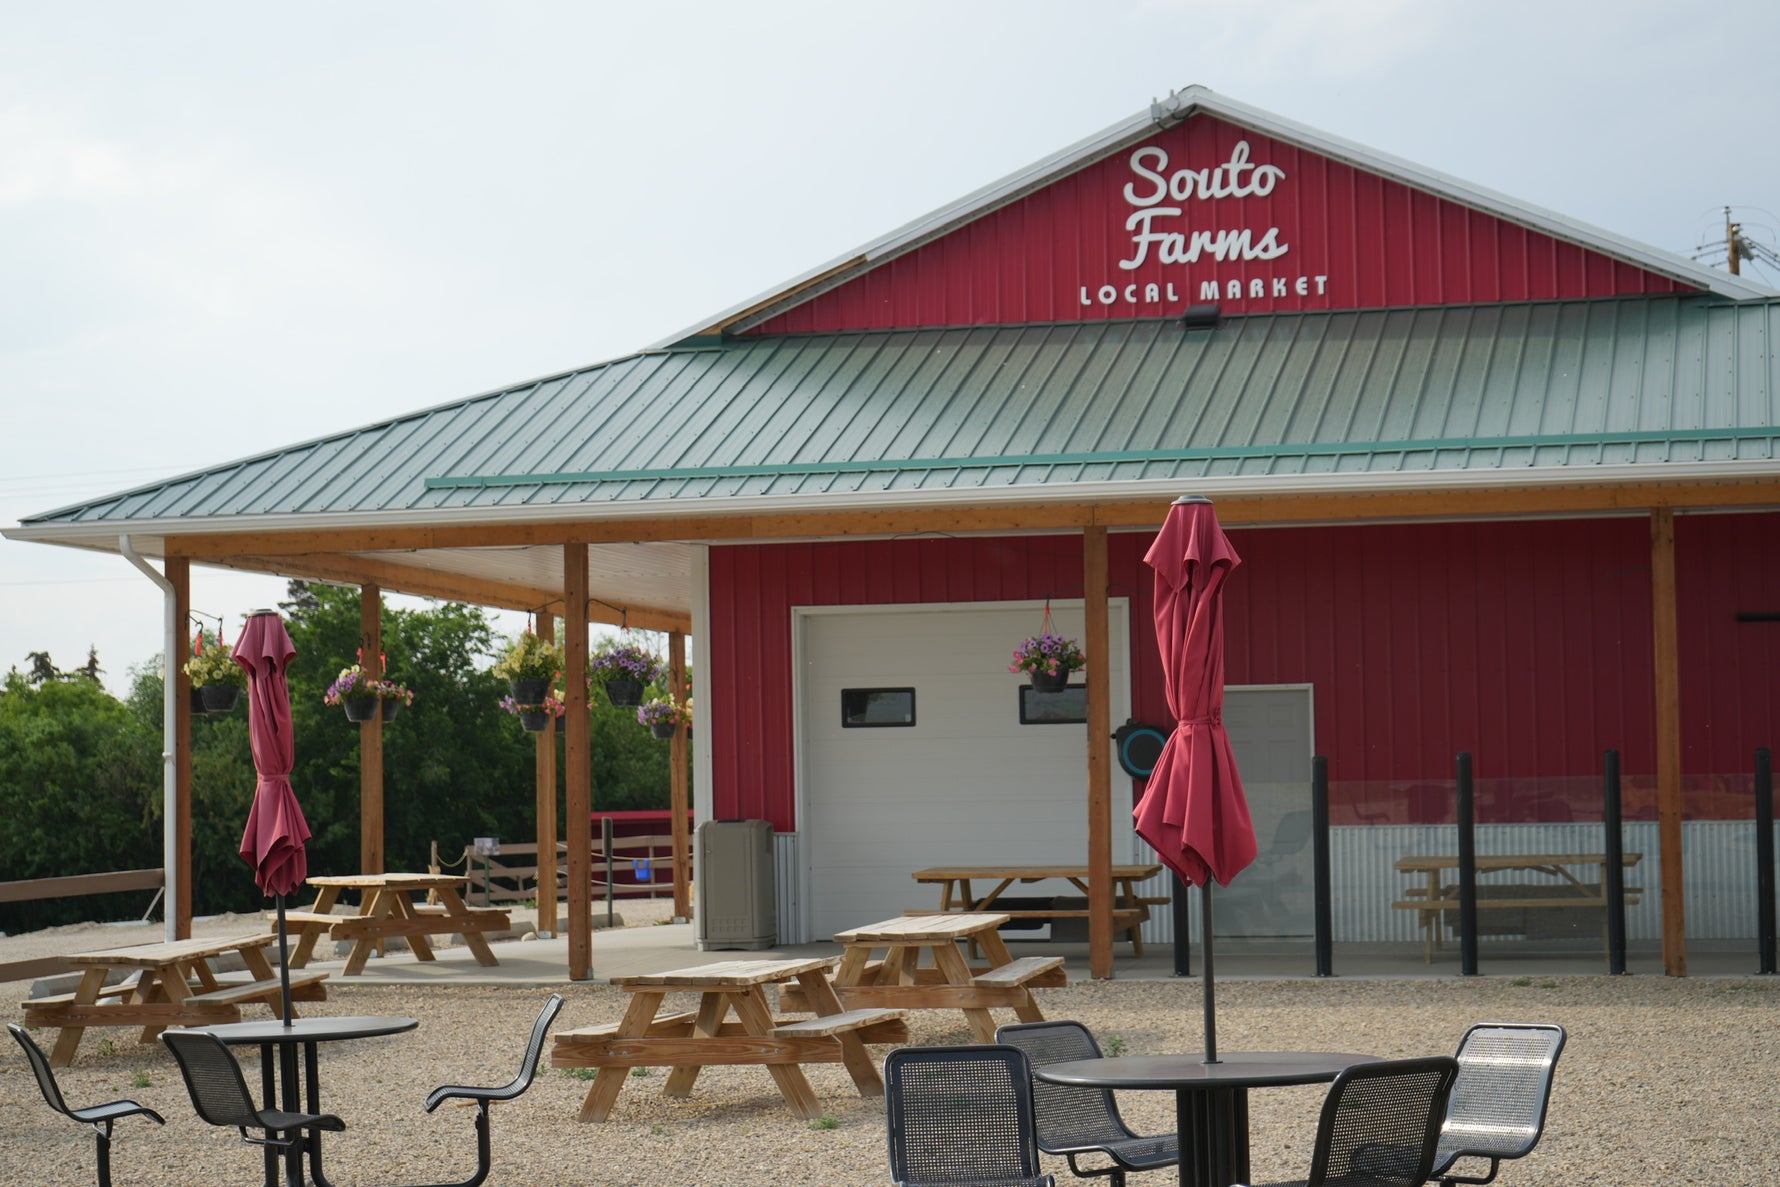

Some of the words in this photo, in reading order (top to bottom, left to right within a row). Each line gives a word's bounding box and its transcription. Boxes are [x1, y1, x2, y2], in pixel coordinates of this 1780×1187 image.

[1123, 140, 1286, 206] Souto
[1118, 207, 1288, 270] Farms
[1080, 282, 1179, 305] LOCAL
[1200, 275, 1328, 300] MARKET
